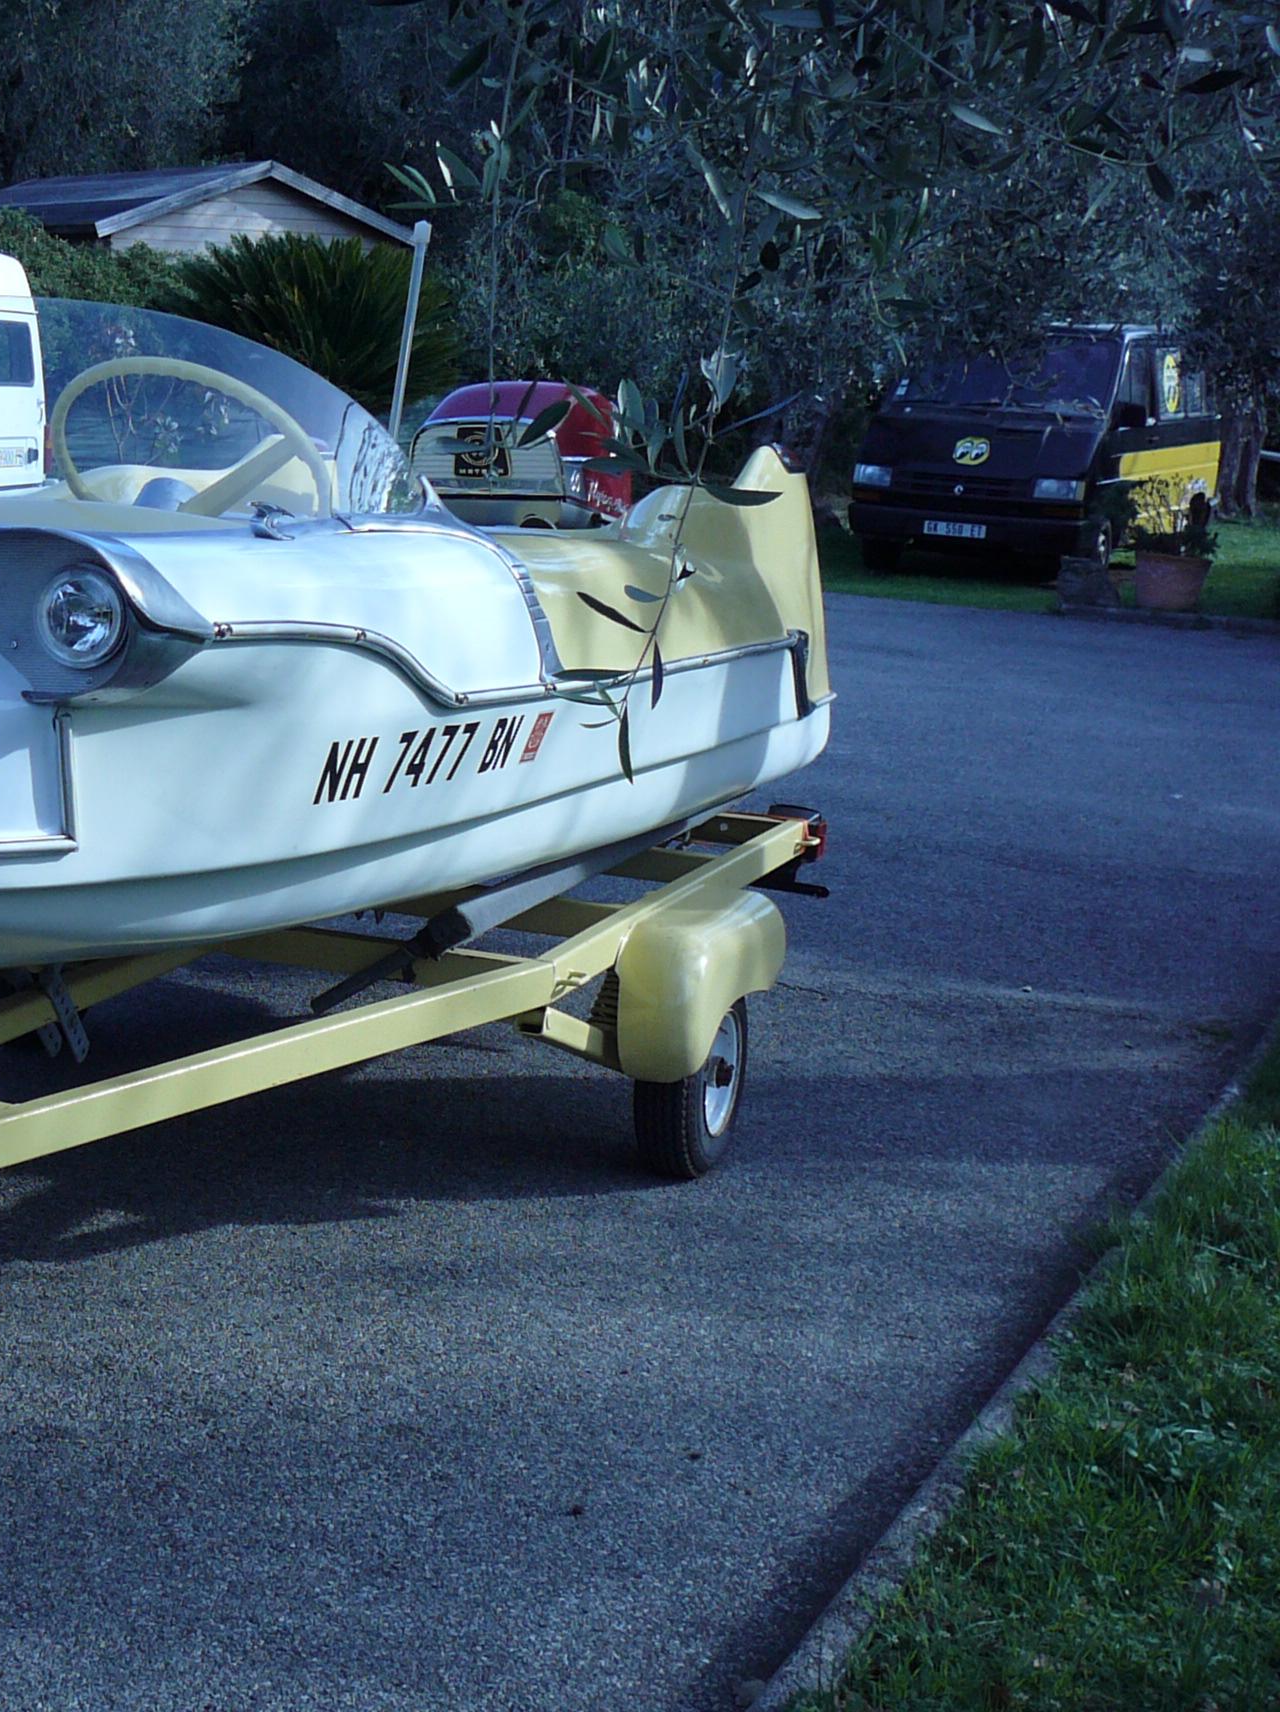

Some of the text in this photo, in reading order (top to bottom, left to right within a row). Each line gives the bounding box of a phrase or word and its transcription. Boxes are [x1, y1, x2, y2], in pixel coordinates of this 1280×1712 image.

[313, 736, 380, 805] NH
[382, 721, 481, 794] 7477
[477, 714, 525, 774] BN
